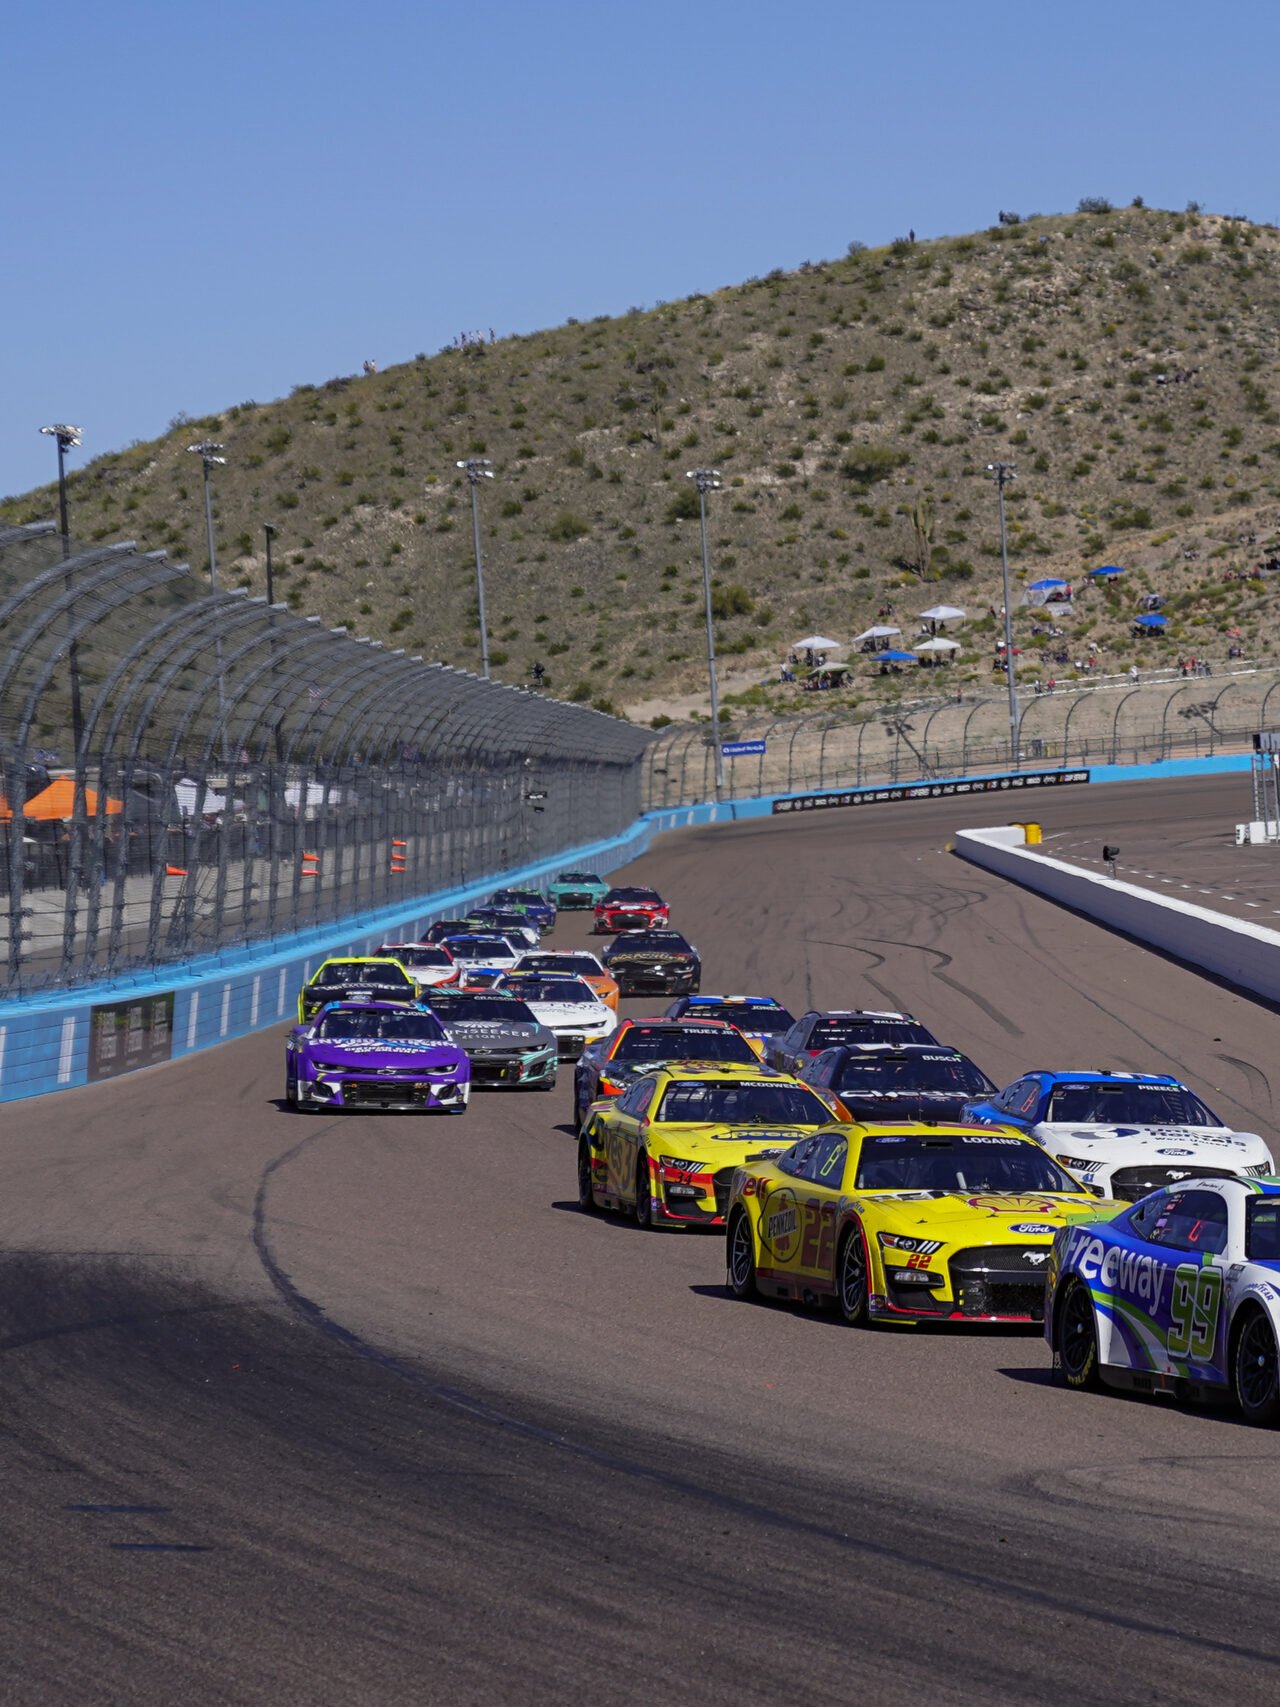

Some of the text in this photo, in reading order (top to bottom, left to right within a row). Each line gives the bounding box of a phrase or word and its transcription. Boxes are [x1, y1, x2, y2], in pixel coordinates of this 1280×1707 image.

[682, 1028, 714, 1036] TRUEX
[922, 1054, 962, 1063] BUSCH
[740, 1081, 803, 1089] MCDOWELL
[1138, 1084, 1181, 1092] PREECE
[962, 1136, 1021, 1146] LOGANO
[1163, 1149, 1188, 1157] Ford
[674, 1172, 692, 1185] 34
[1082, 1173, 1095, 1183] 41
[767, 1208, 798, 1239] PENNZOIL
[1018, 1223, 1050, 1233] Ford
[801, 1197, 837, 1272] 22
[906, 1253, 932, 1269] 22
[1061, 1228, 1168, 1316] Freeway
[1167, 1262, 1224, 1362] 99
